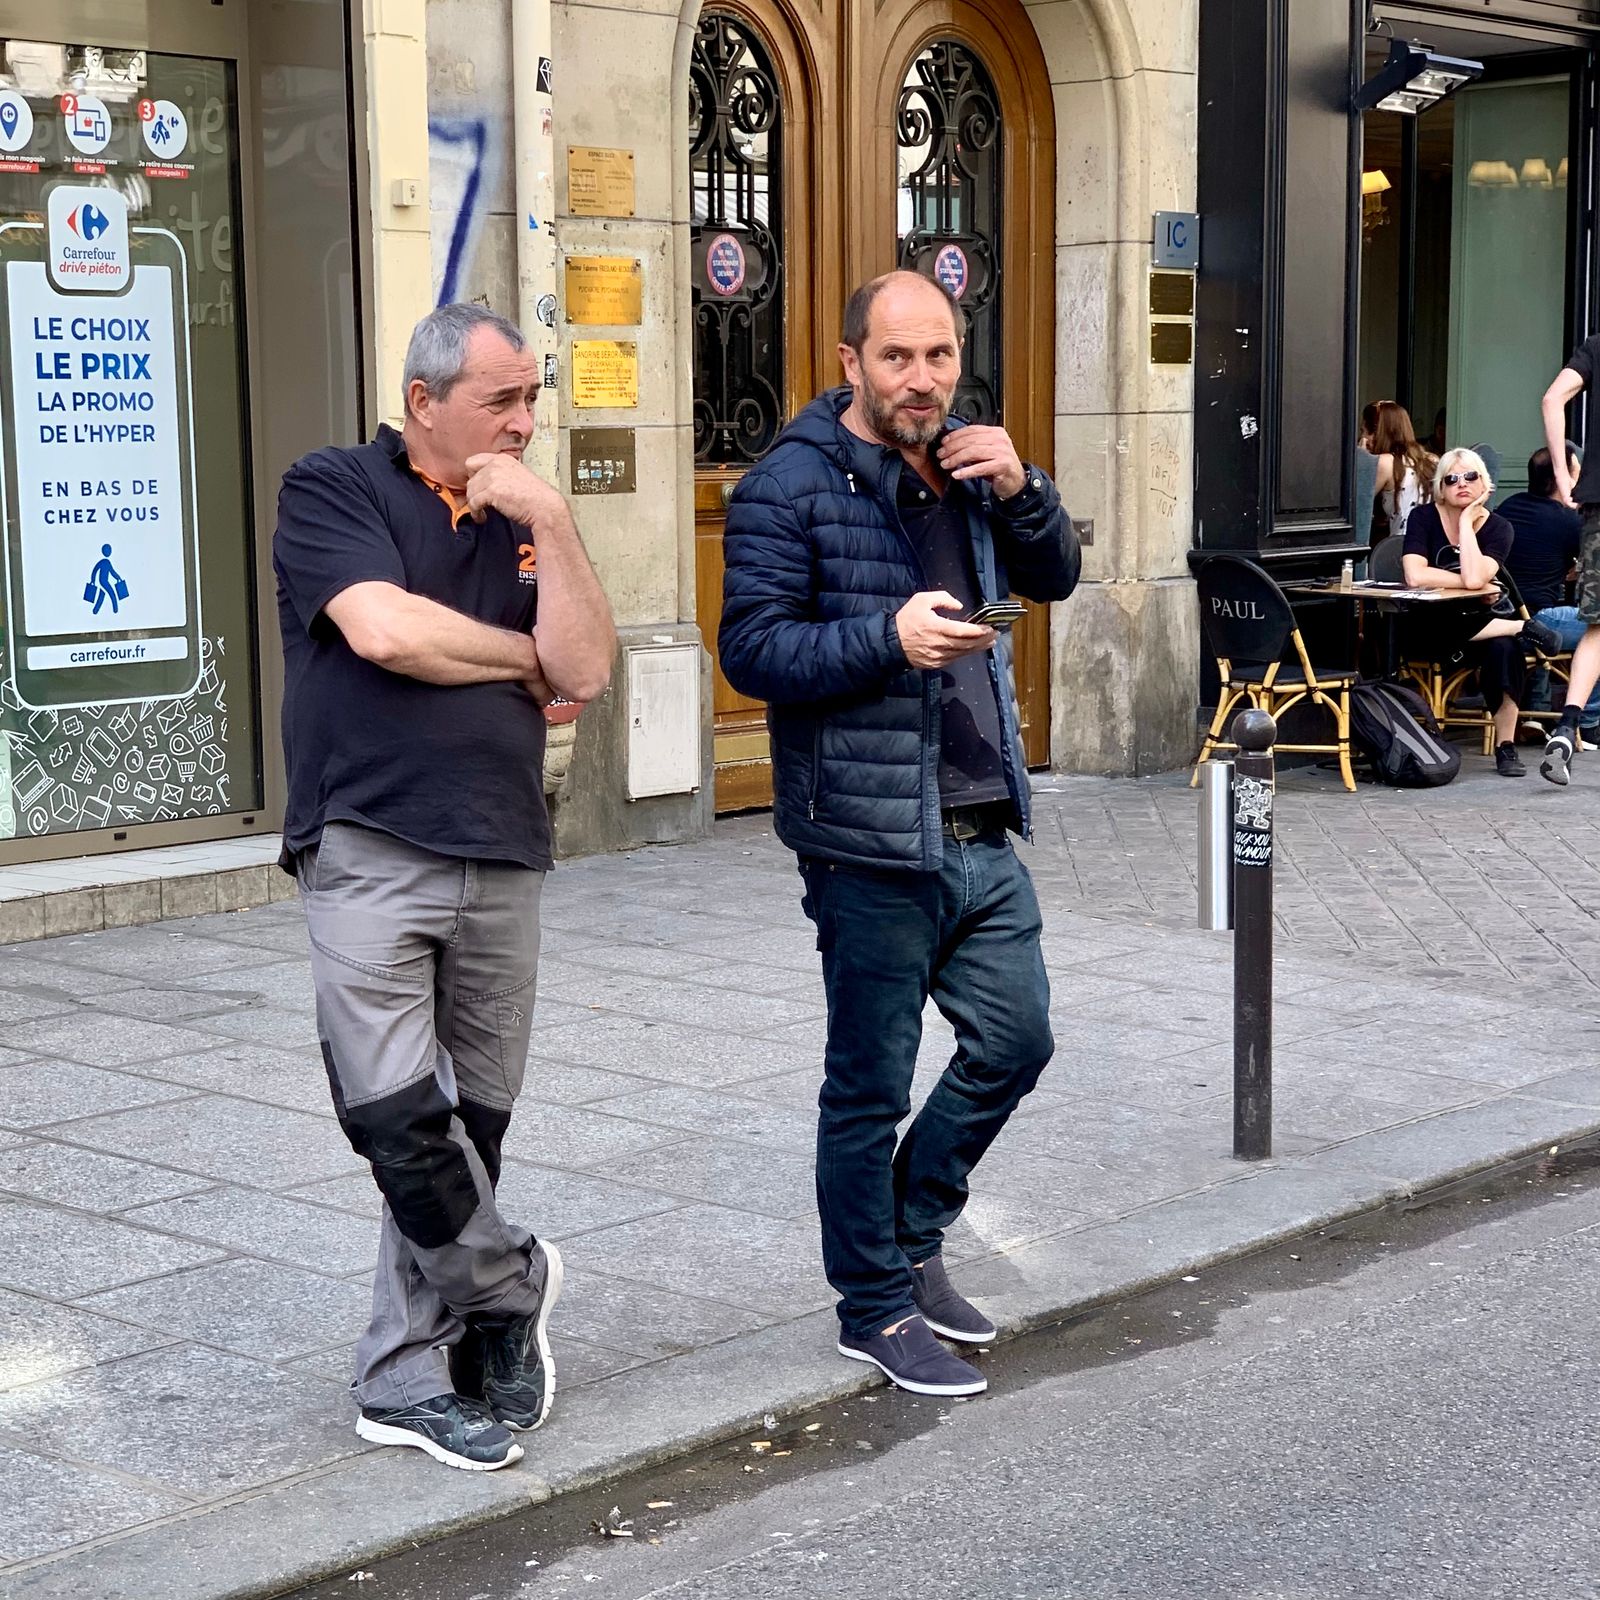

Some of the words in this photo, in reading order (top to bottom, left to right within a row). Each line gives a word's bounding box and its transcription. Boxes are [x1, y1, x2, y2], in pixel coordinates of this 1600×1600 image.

[64, 95, 74, 114] 2
[143, 101, 152, 119] 3
[63, 246, 116, 260] Carrefour
[59, 261, 87, 273] drive
[88, 262, 121, 276] piéton
[34, 317, 63, 340] LE
[71, 317, 151, 341] CHOIX
[36, 352, 72, 380] LE
[81, 352, 152, 380] PRIX
[38, 391, 66, 411] LA
[72, 391, 154, 411] PROMO
[40, 424, 68, 443] DE
[42, 481, 69, 497] EN
[80, 480, 121, 496] BAS
[132, 479, 158, 495] DE
[44, 508, 97, 524] CHEZ
[106, 506, 159, 522] VOUS
[518, 543, 536, 572] 2
[1211, 597, 1265, 620] PAUL
[70, 645, 146, 662] carrefour.fr
[1253, 833, 1271, 847] YOU
